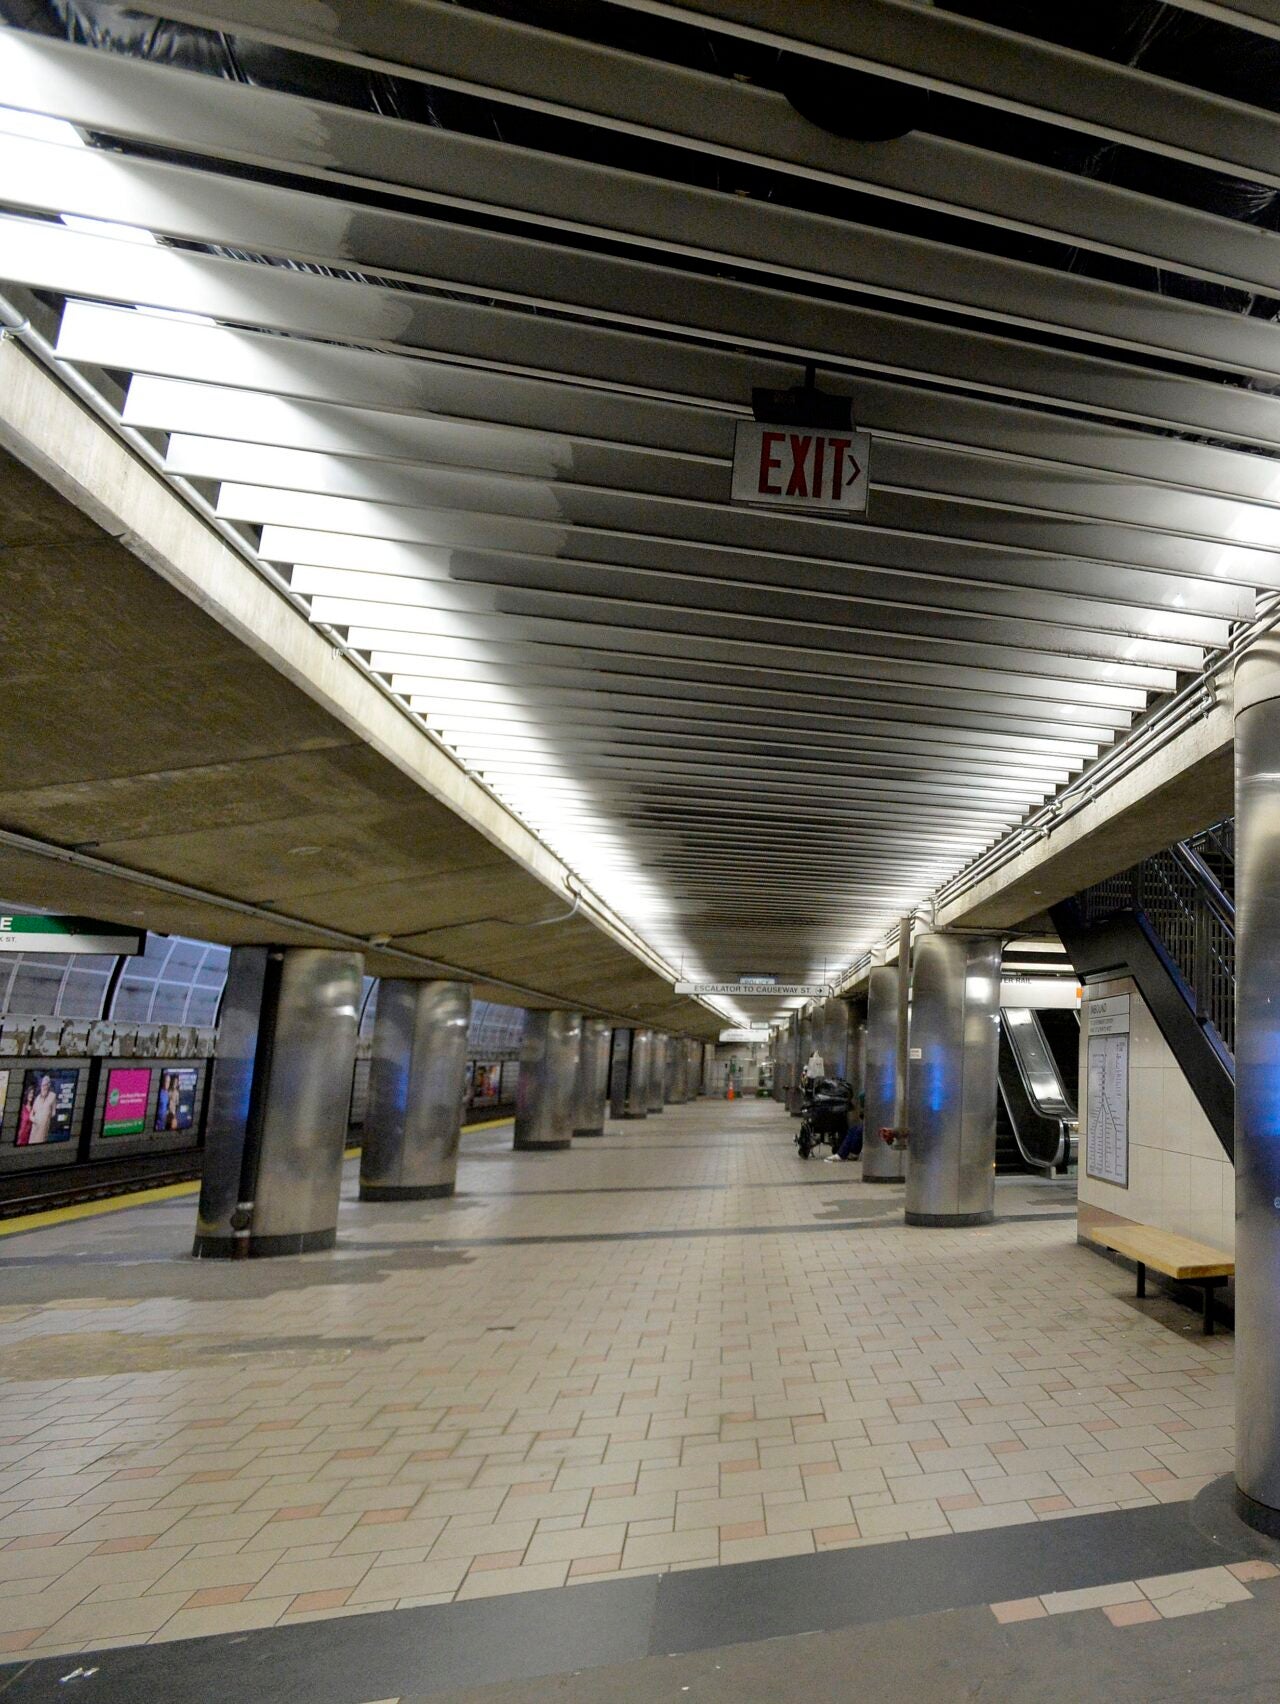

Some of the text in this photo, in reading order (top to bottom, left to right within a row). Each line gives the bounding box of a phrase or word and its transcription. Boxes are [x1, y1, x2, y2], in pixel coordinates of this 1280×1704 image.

[758, 431, 852, 500] EXIT
[694, 985, 741, 993] ESCALATOR
[756, 986, 798, 994] CAUSEWAY
